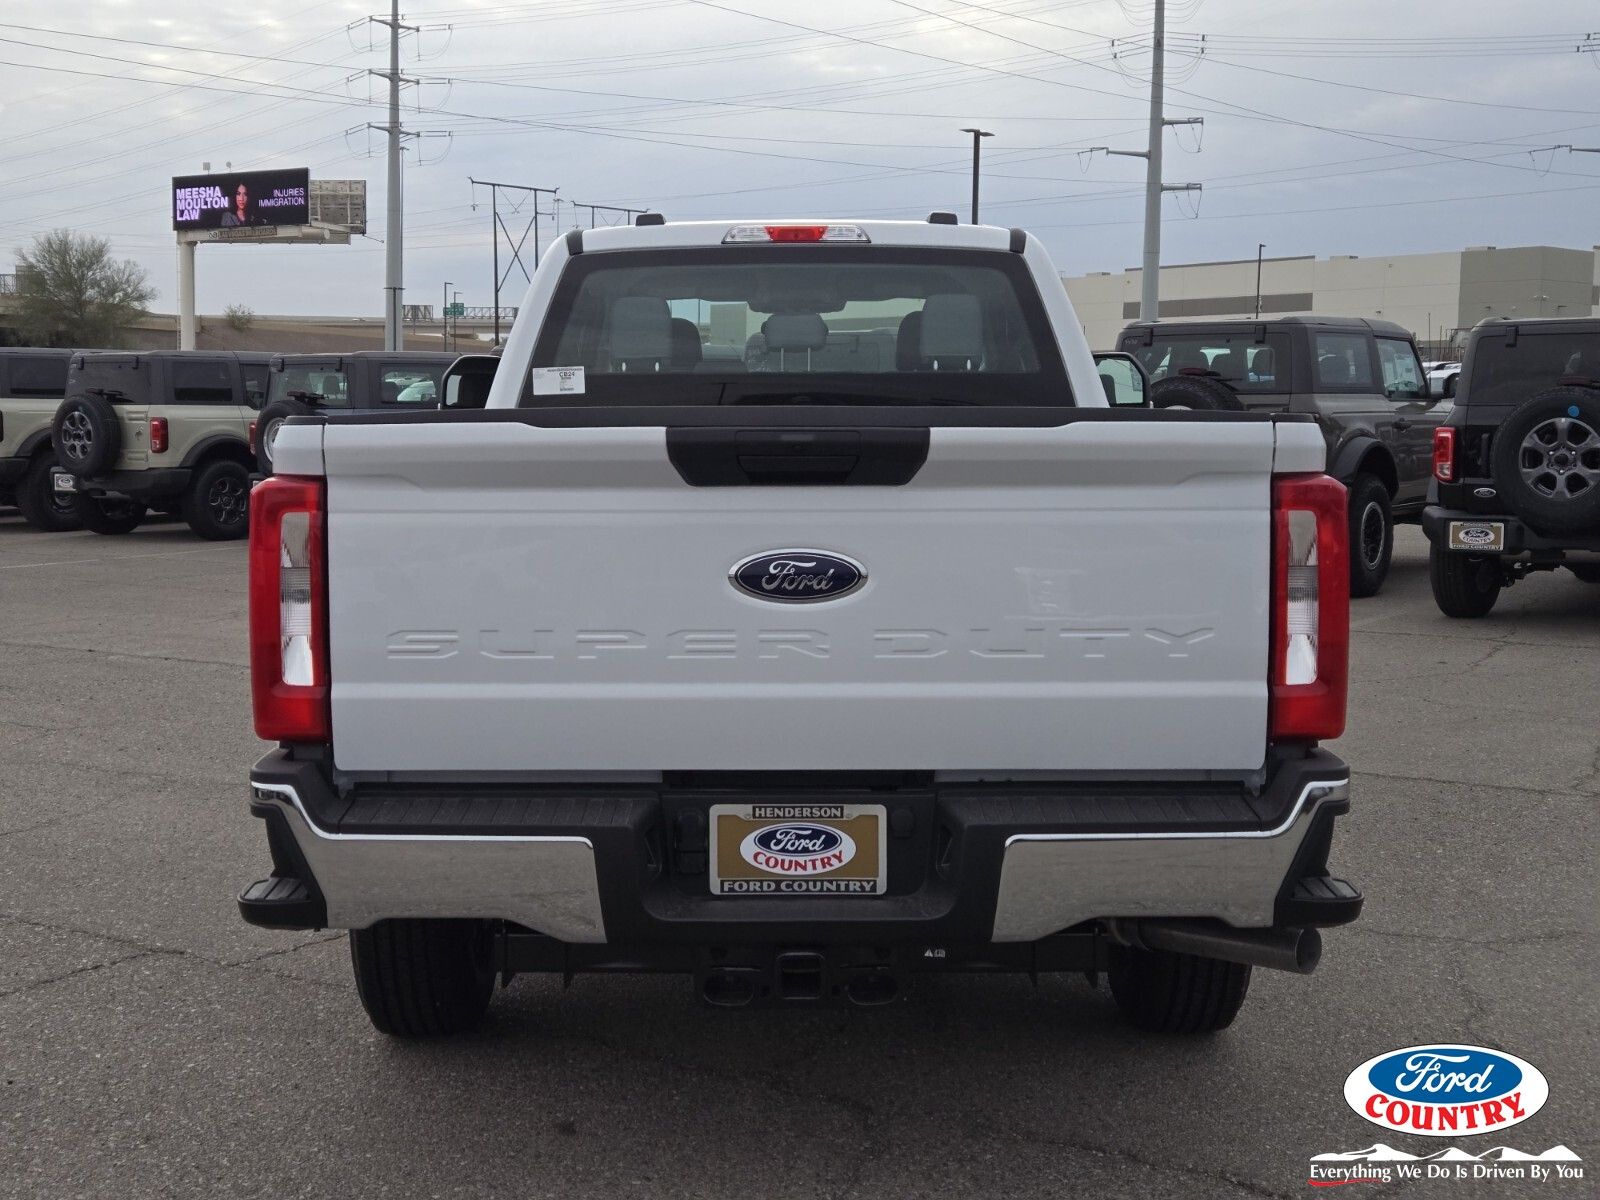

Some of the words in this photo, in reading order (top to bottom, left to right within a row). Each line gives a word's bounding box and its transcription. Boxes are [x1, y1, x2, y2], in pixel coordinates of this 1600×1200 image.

[176, 186, 221, 199] MEESHA
[273, 188, 304, 197] INJURIES
[176, 197, 228, 210] MOULTON
[258, 197, 304, 207] IMMIGRATION
[176, 209, 199, 221] LAW
[761, 560, 835, 590] Ford
[387, 630, 831, 659] SUPER
[873, 628, 1215, 658] DUTY
[755, 807, 842, 818] HENDERSON
[770, 828, 825, 851] Ford
[753, 850, 844, 872] COUNTRY
[723, 881, 776, 892] FORD
[780, 881, 875, 892] COUNTRY
